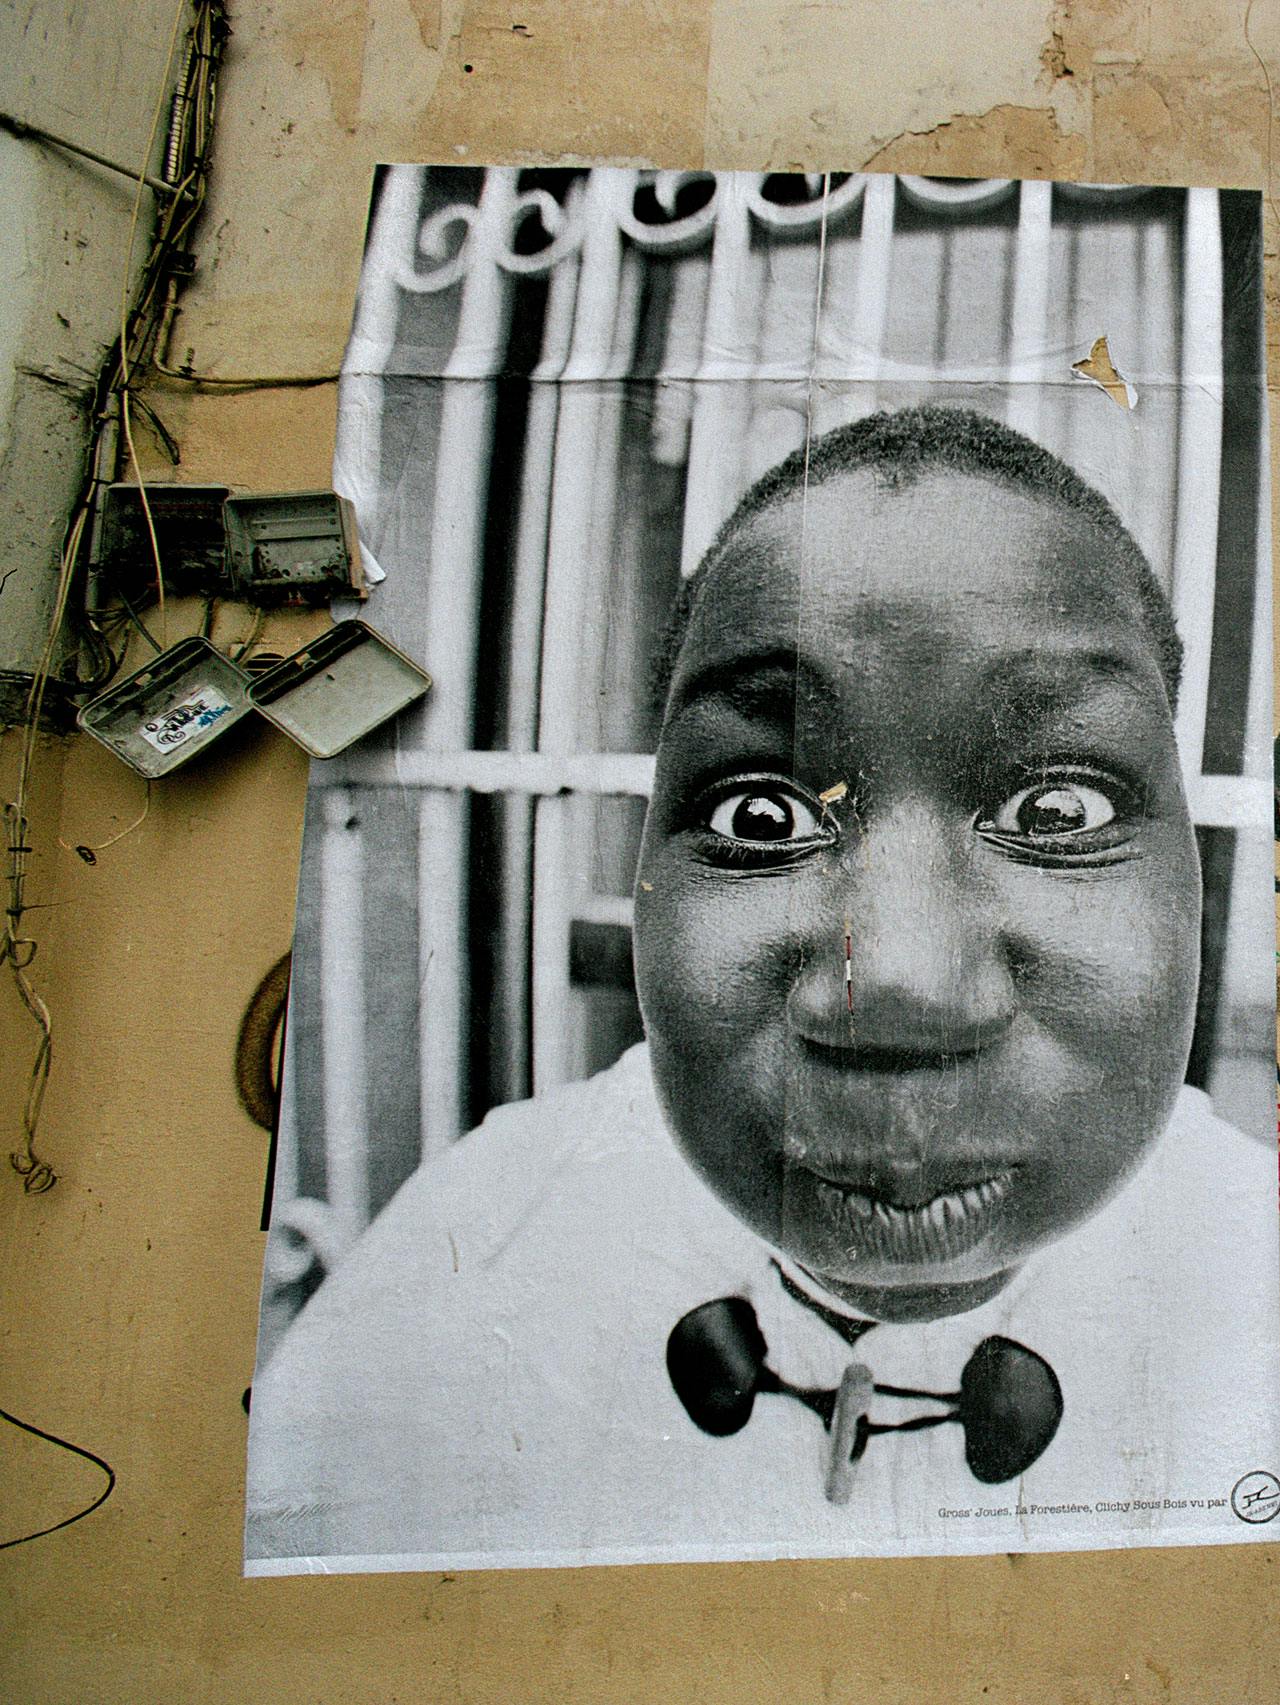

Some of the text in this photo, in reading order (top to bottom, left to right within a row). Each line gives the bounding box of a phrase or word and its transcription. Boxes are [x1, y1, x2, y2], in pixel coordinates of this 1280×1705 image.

[1015, 1504, 1028, 1516] La
[1095, 1501, 1131, 1513] Clichy
[1133, 1500, 1161, 1511] Sous
[1163, 1499, 1188, 1510] Bois
[1190, 1499, 1205, 1508] vu
[1207, 1499, 1229, 1510] par
